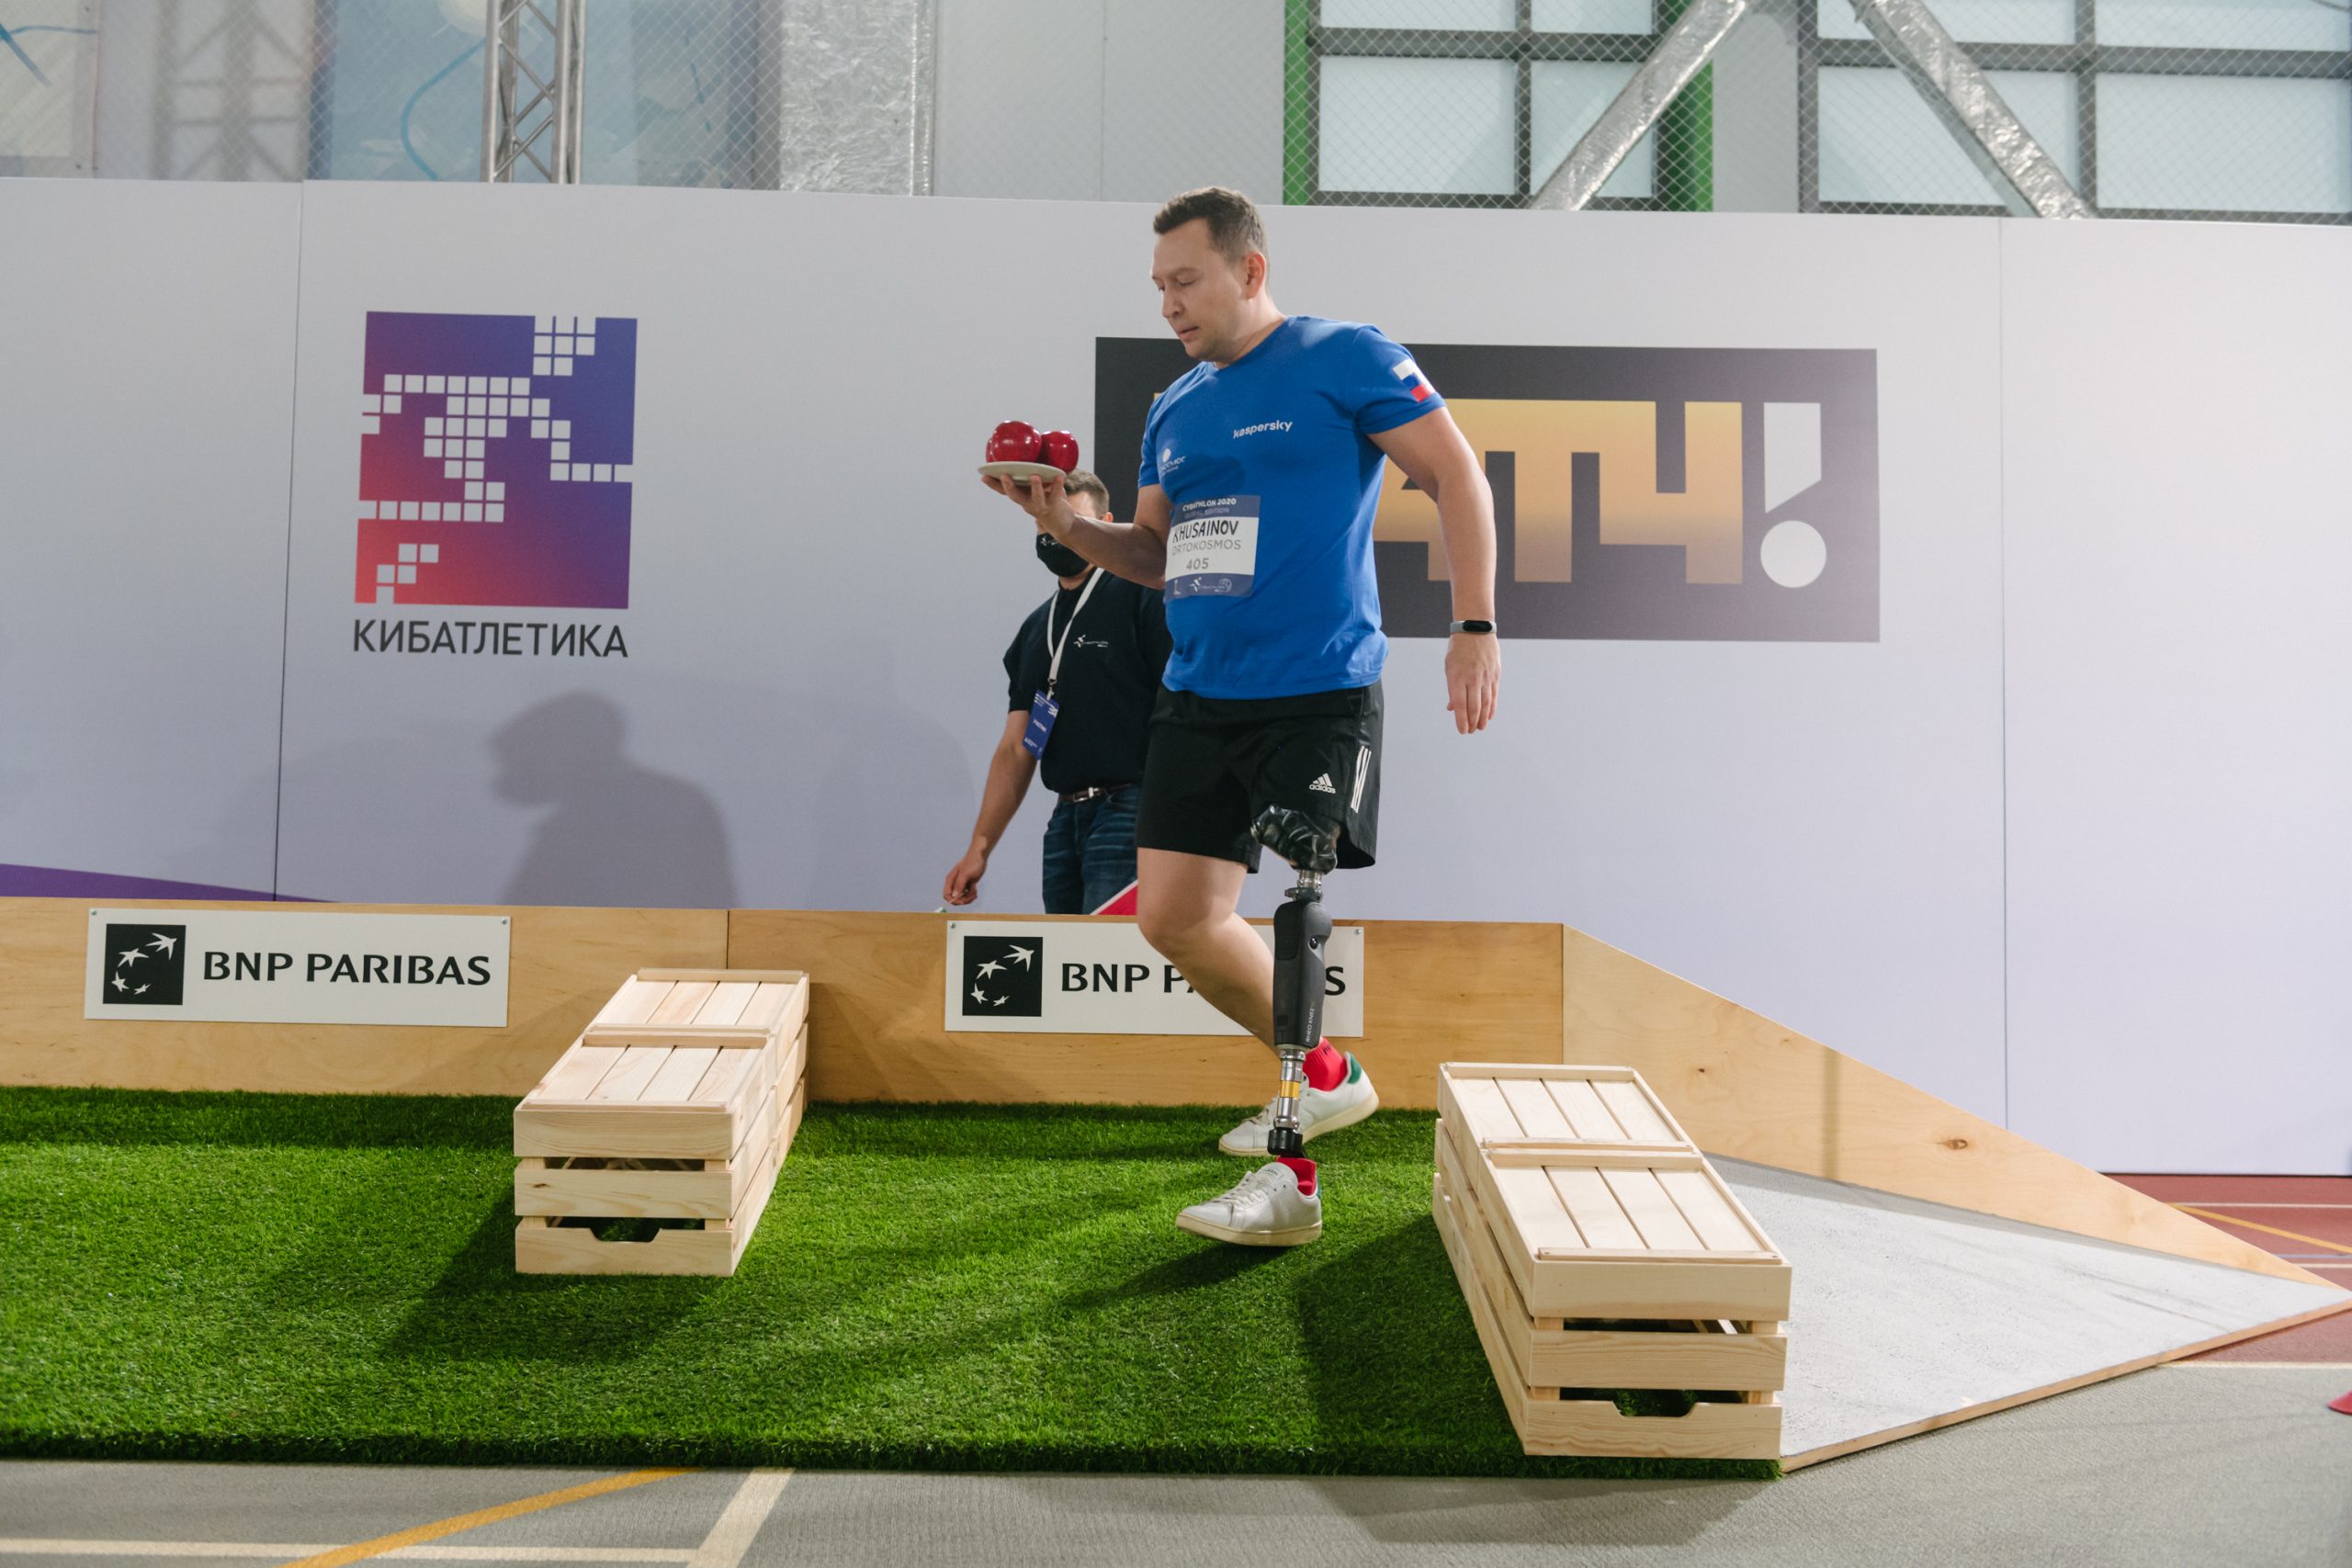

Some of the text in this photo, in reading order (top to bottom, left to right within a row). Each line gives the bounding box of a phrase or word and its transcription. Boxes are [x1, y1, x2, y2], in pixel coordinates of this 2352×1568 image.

[1233, 420, 1293, 439] kaspersky
[1182, 500, 1216, 512] CYBATHLON
[1172, 520, 1238, 543] KHUSAINOV
[1171, 539, 1241, 557] ORTOKOSMOS
[1186, 558, 1209, 570] 405
[354, 619, 628, 658] КИБАТЛЕТИКА
[1309, 784, 1336, 795] adidas
[203, 951, 492, 986] BNP PARIBAS
[1061, 963, 1149, 993] BNP
